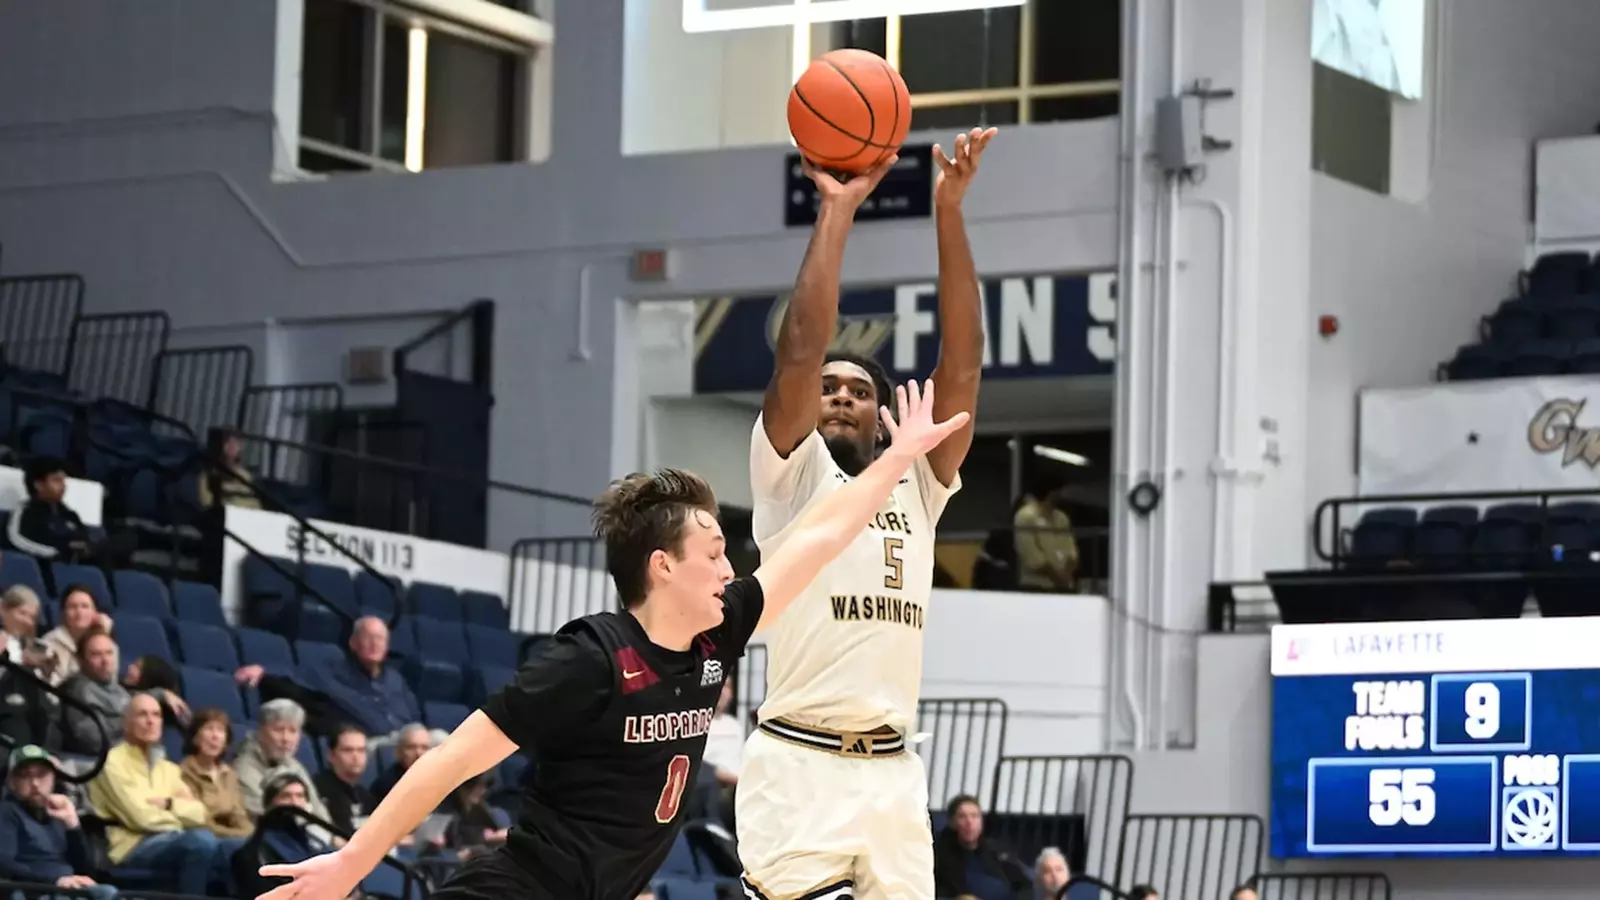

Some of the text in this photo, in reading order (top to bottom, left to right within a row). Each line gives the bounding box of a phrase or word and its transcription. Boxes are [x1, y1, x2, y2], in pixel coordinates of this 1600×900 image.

[893, 276, 1053, 371] FN
[382, 541, 413, 570] 113
[883, 537, 904, 590] 5
[1333, 632, 1444, 656] LAFAYETTE
[624, 708, 713, 743] LEOPARDS
[1345, 715, 1425, 751] FOULS
[1352, 681, 1500, 739] TEAM 9
[655, 755, 690, 823] 0
[1369, 768, 1436, 826] 55
